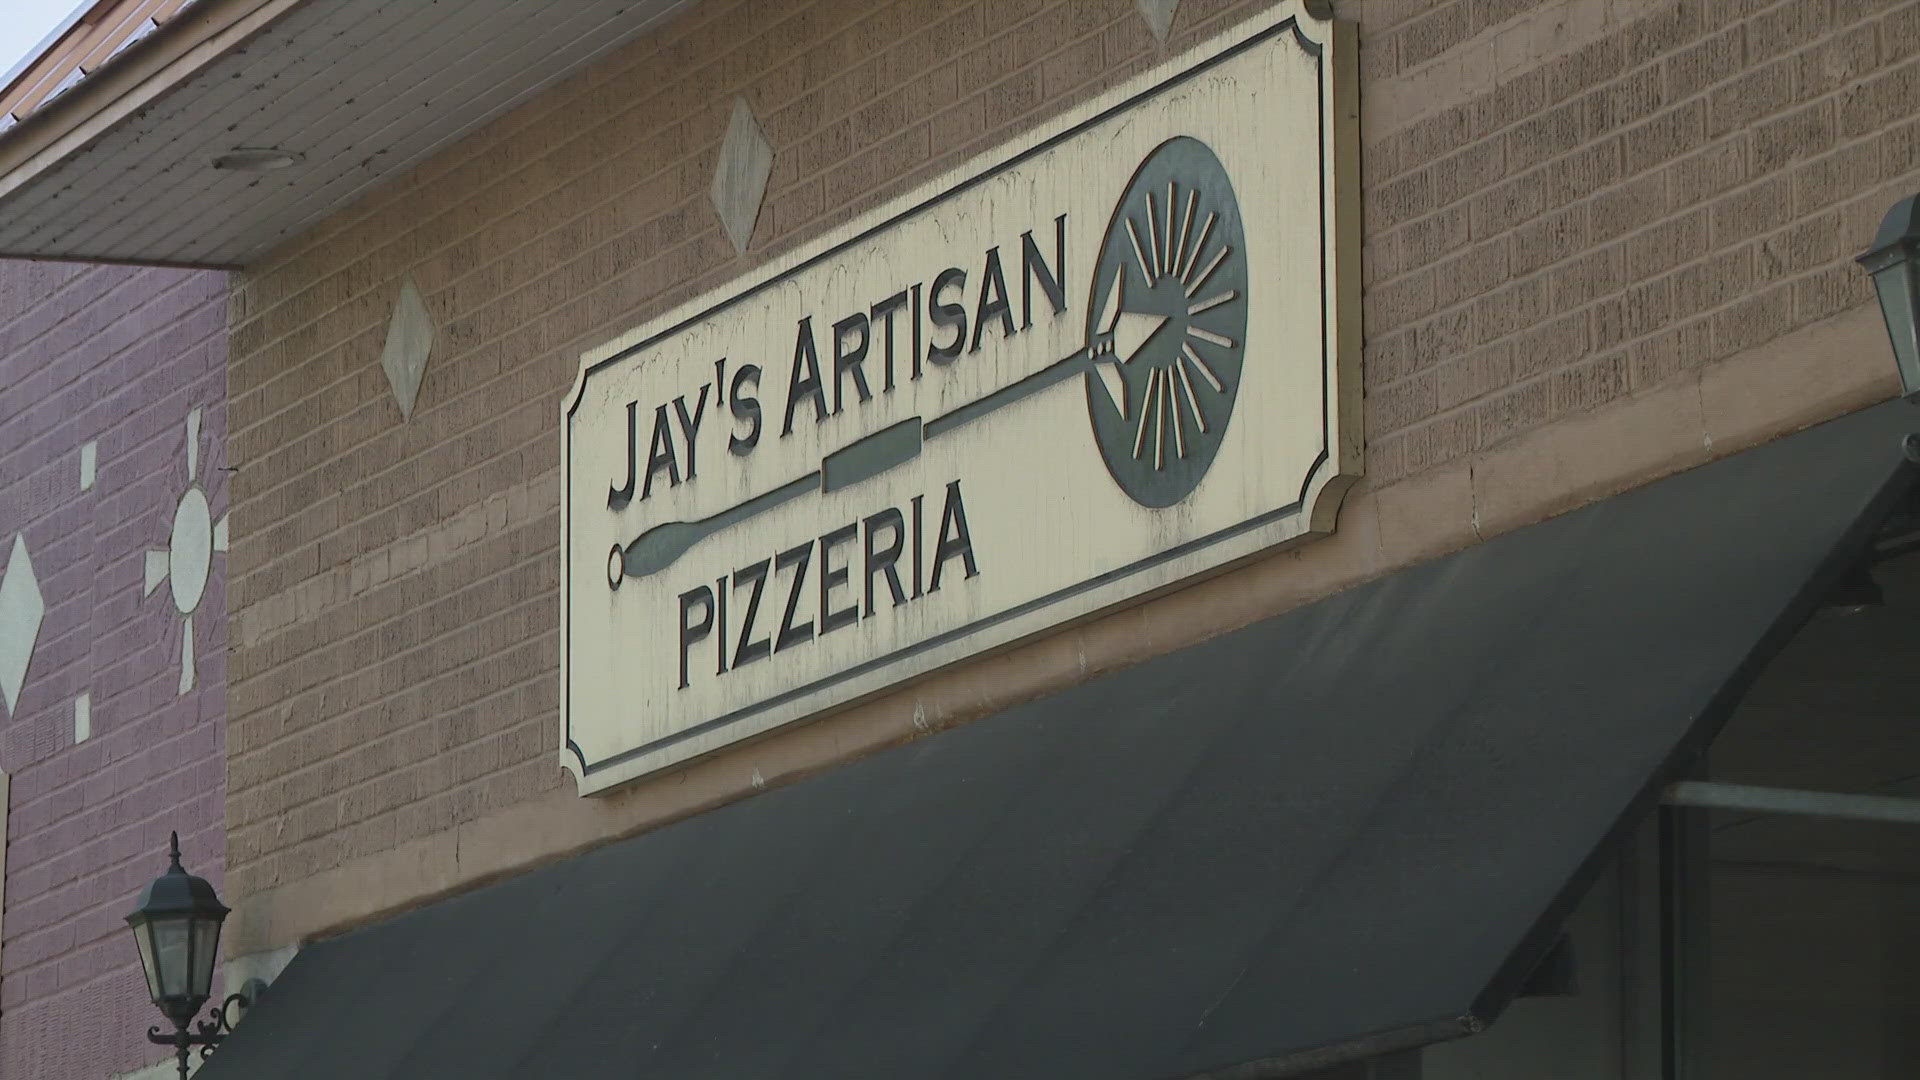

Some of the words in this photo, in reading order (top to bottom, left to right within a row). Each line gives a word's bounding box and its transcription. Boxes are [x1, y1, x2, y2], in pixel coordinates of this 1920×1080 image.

[607, 357, 763, 511] JAY'S
[780, 213, 1068, 440] ARTISAN
[677, 479, 981, 691] PIZZERIA
